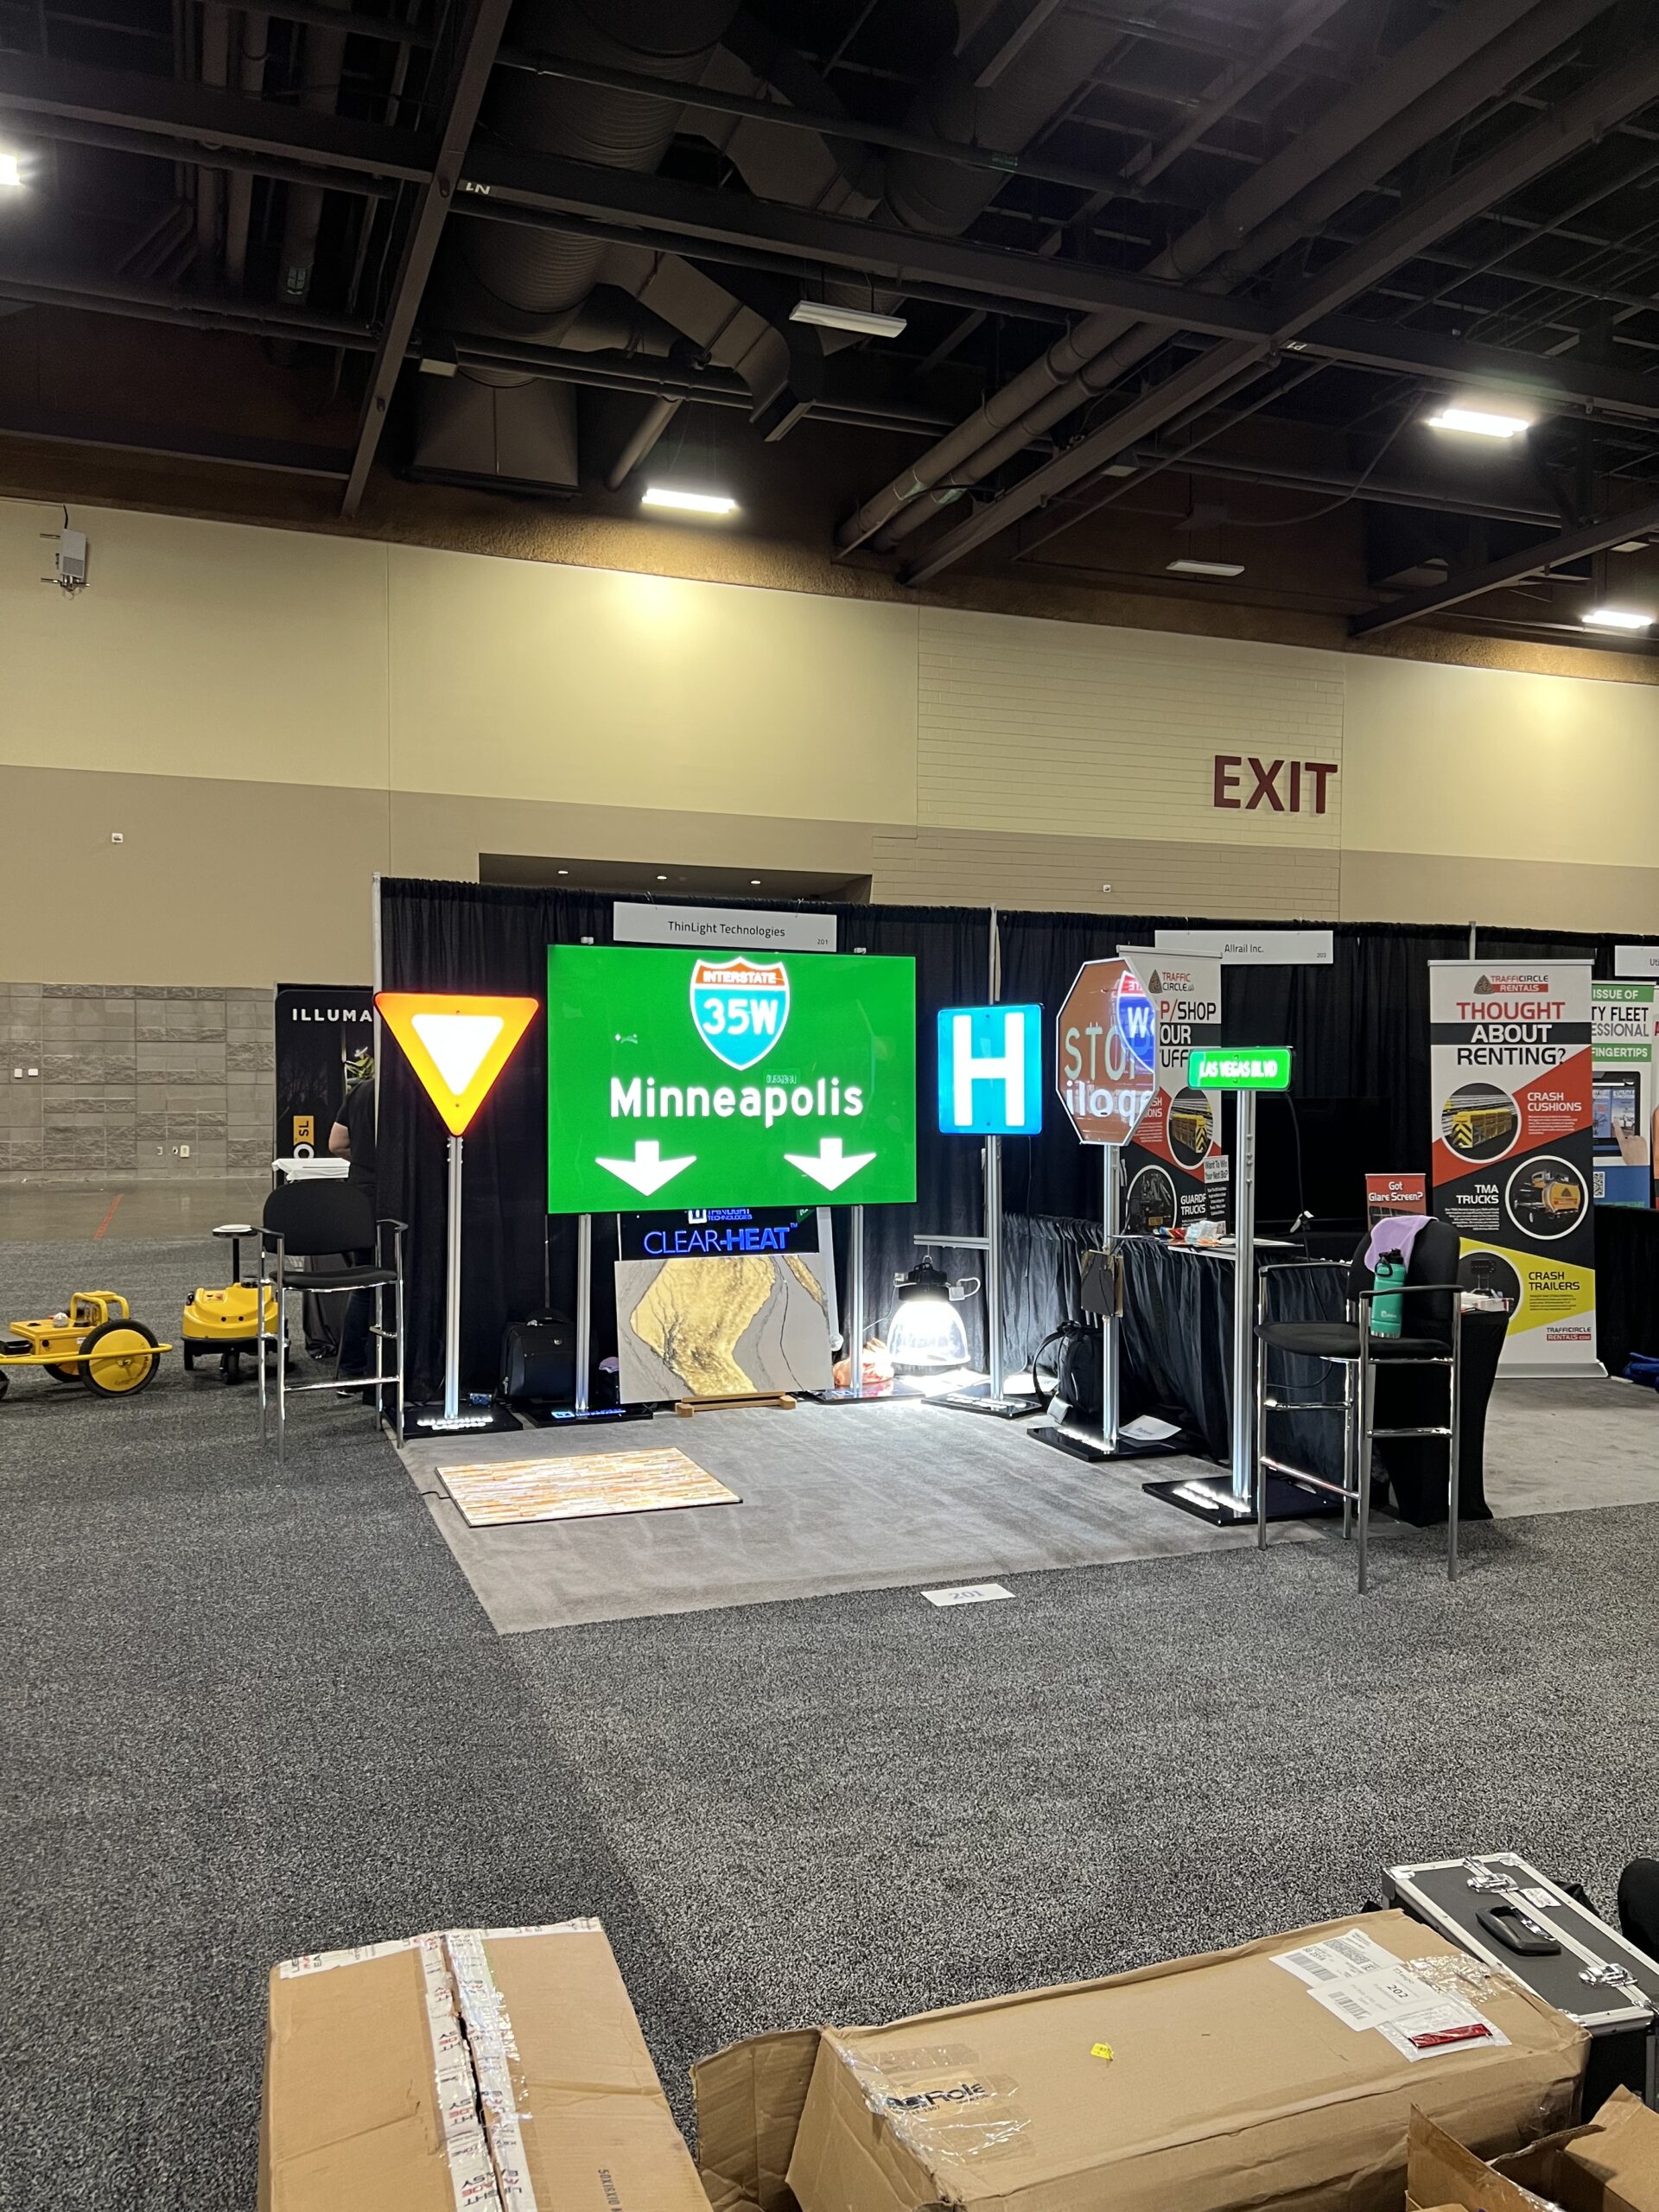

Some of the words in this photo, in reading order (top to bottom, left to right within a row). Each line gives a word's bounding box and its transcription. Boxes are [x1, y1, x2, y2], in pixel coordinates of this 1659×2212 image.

[1214, 755, 1338, 814] EXIT
[668, 921, 716, 935] ThinLight
[720, 924, 785, 938] Technologies
[1224, 944, 1248, 953] Allrail
[1250, 944, 1263, 953] Inc.
[703, 970, 777, 984] INTERSTATE
[1162, 972, 1191, 982] TRAFFIC
[1592, 988, 1623, 999] ISSUE
[1624, 990, 1638, 999] OF
[702, 997, 778, 1035] 35W
[1160, 999, 1217, 1021] P/SHOP
[1456, 1001, 1566, 1020] THOUGHT
[1611, 1007, 1649, 1021] FLEET
[1160, 1024, 1192, 1045] OUR
[1471, 1024, 1552, 1043] ABOUT
[1592, 1023, 1649, 1037] ESSIONAL
[1457, 1047, 1567, 1065] RENTING?
[952, 1011, 1025, 1127] H
[1199, 1060, 1218, 1077] LAS
[1219, 1060, 1250, 1077] VEGAS
[1250, 1059, 1278, 1077] BLVD
[610, 1077, 863, 1128] Minneapolis
[1527, 1092, 1564, 1102] CRASH
[1527, 1102, 1582, 1112] CUSHIONS
[1389, 1181, 1402, 1191] Got
[1474, 1184, 1499, 1194] TMA
[1369, 1192, 1389, 1202] Glare
[1391, 1192, 1423, 1201] Screen?
[1456, 1195, 1499, 1205] TRUCKS
[1180, 1204, 1205, 1216] TRUCKS
[644, 1227, 790, 1254] CLEAR-HEAT
[1529, 1271, 1565, 1280] CRASH
[1529, 1281, 1580, 1291] TRAILERS
[1387, 1984, 1409, 1999] 202
